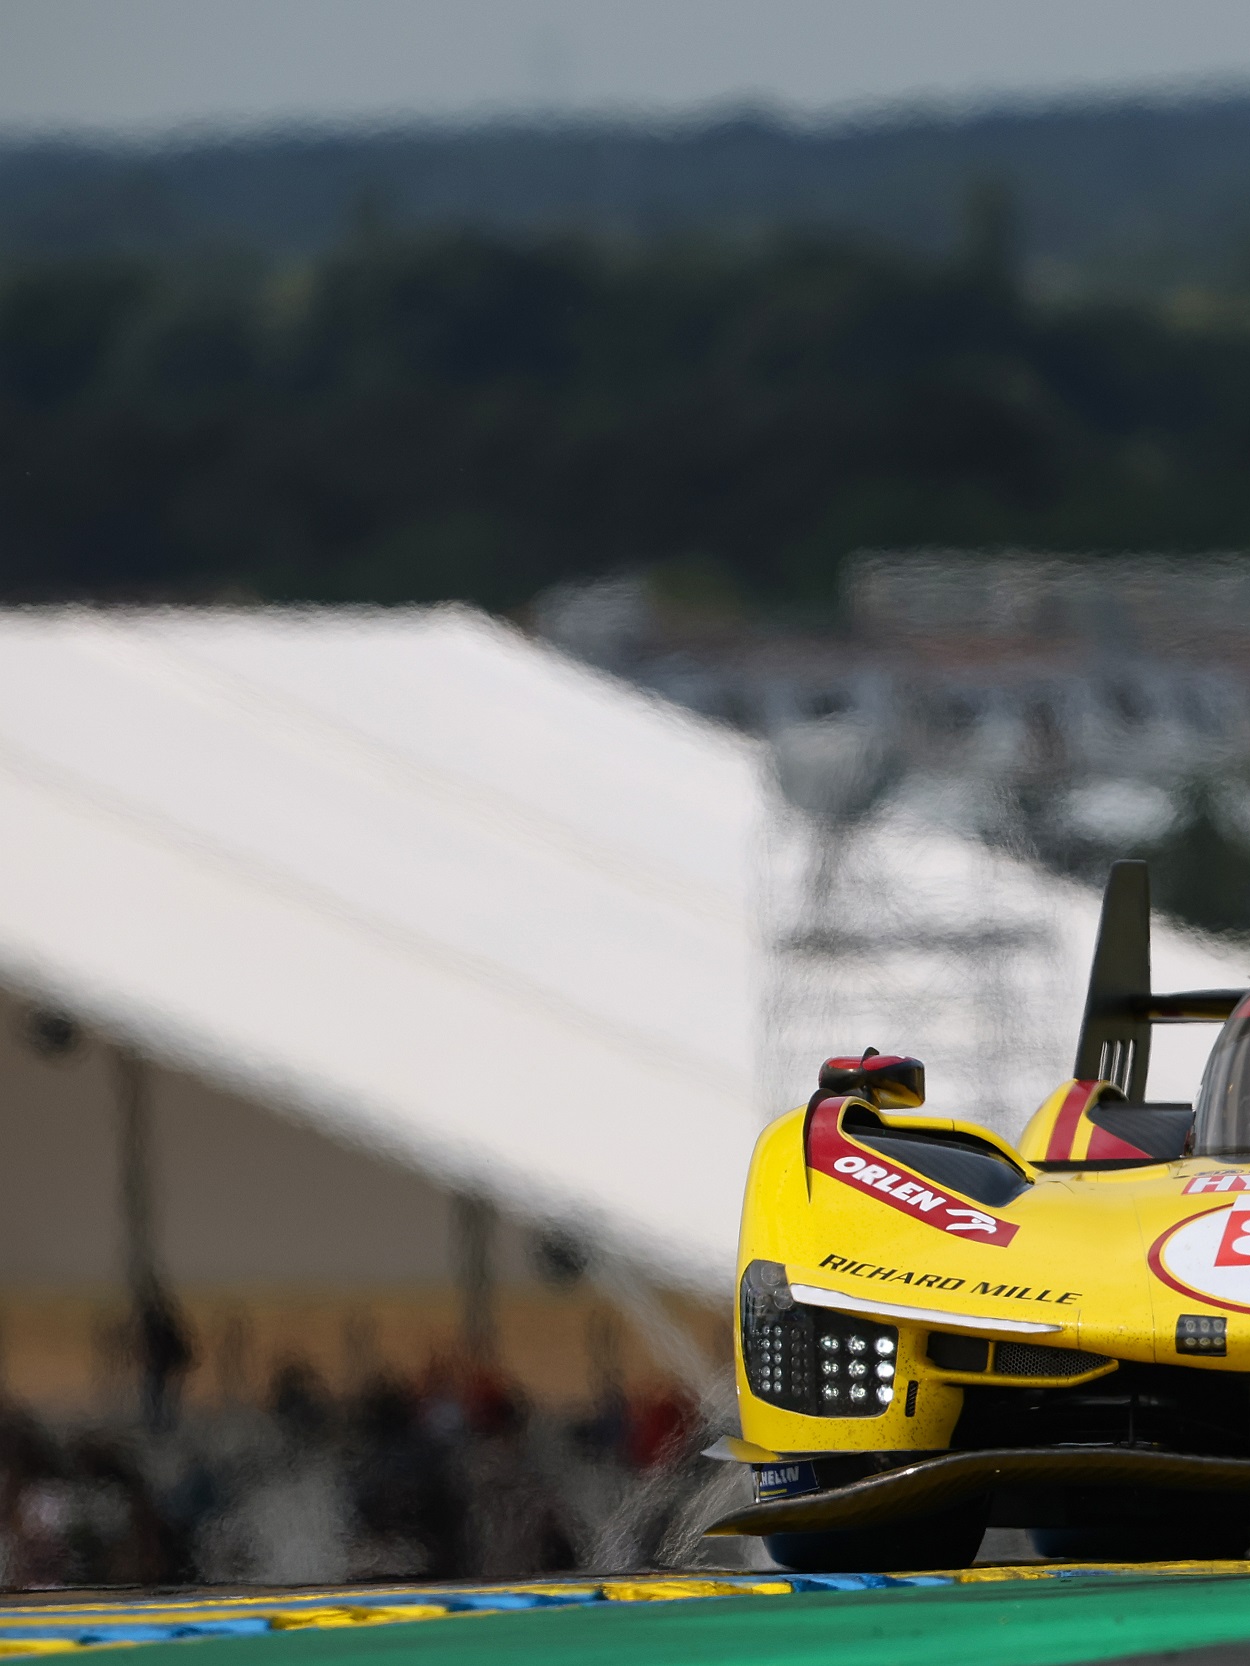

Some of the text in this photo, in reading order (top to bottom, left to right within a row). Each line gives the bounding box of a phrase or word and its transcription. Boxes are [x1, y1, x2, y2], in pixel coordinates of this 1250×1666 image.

[833, 1155, 947, 1213] ORLEN
[818, 1253, 1082, 1306] RICHARD MILLE
[752, 1466, 800, 1488] HELIN
